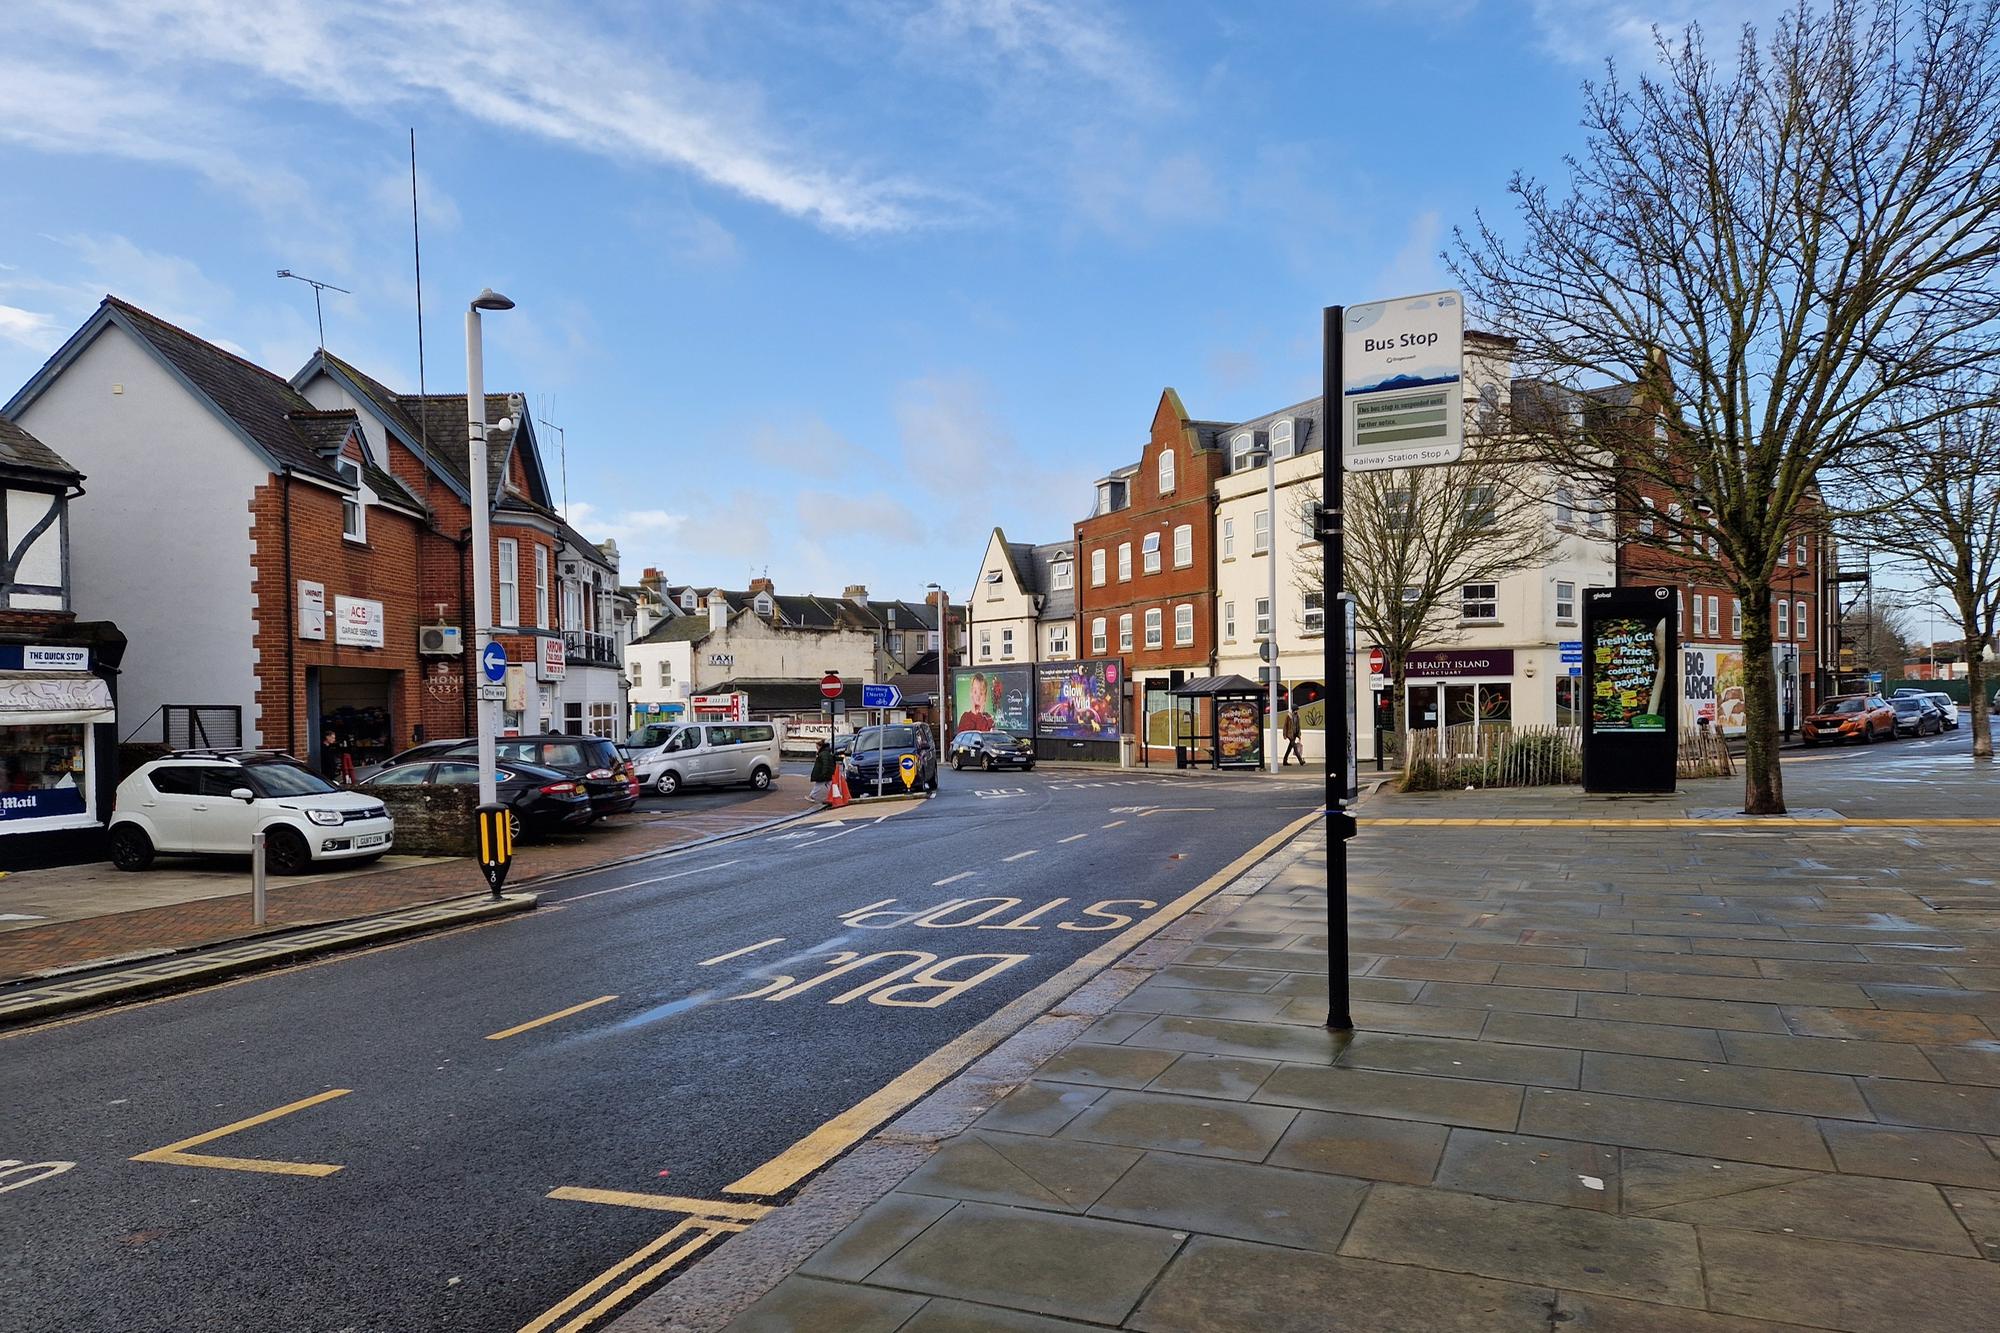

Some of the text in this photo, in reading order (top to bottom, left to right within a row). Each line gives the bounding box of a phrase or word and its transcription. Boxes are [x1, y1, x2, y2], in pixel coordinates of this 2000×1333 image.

[1364, 332, 1438, 352] Bus Stop
[1382, 404, 1393, 412] stop
[1401, 400, 1429, 409] suspended
[1358, 420, 1378, 428] further
[1354, 455, 1385, 466] Railway
[1388, 452, 1418, 462] Station
[1421, 450, 1442, 460] Stop
[1592, 592, 1612, 600] global
[350, 606, 366, 618] ACE
[342, 626, 378, 638] GARAGE SERVICES
[1597, 632, 1654, 646] Freshly Cut
[30, 652, 84, 660] THE QUICK STOP
[1620, 646, 1652, 656] Prices
[1417, 661, 1452, 669] BEAUTY
[1455, 660, 1490, 668] ISLAND
[1684, 652, 1704, 676] BIG
[1608, 666, 1642, 676] cooking
[429, 676, 464, 684] HONE
[1614, 676, 1652, 688] payday.
[484, 688, 505, 698] One way
[1063, 684, 1083, 696] Glow
[1684, 676, 1715, 700] ARCH
[1073, 697, 1090, 710] Wild
[3, 795, 38, 809] Mail
[837, 897, 1158, 931] STOP
[729, 951, 1031, 1008] BUS
